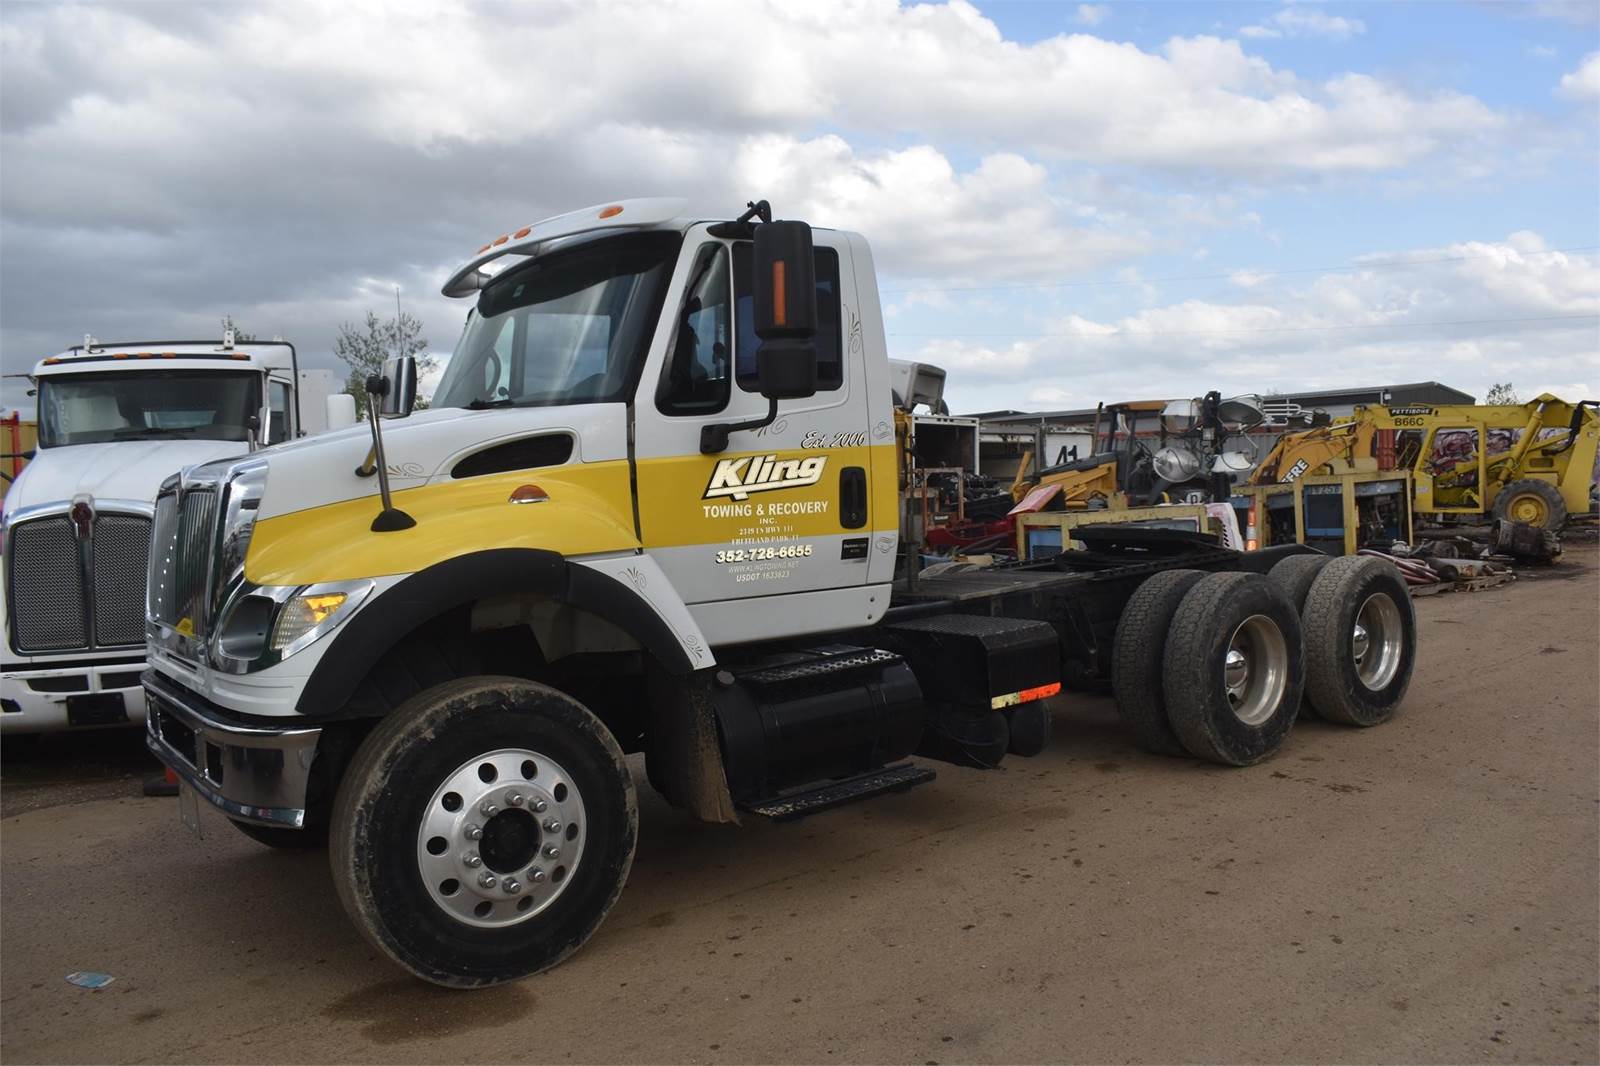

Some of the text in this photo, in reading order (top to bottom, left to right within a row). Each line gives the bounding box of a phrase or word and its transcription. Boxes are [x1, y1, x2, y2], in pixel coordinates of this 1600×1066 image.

[701, 453, 830, 502] Kling
[1282, 459, 1309, 483] ERE
[703, 501, 830, 518] TOWING & RECOVERY
[759, 517, 778, 525] INC.
[715, 544, 813, 564] 352-728-6655
[736, 572, 761, 583] USDOT
